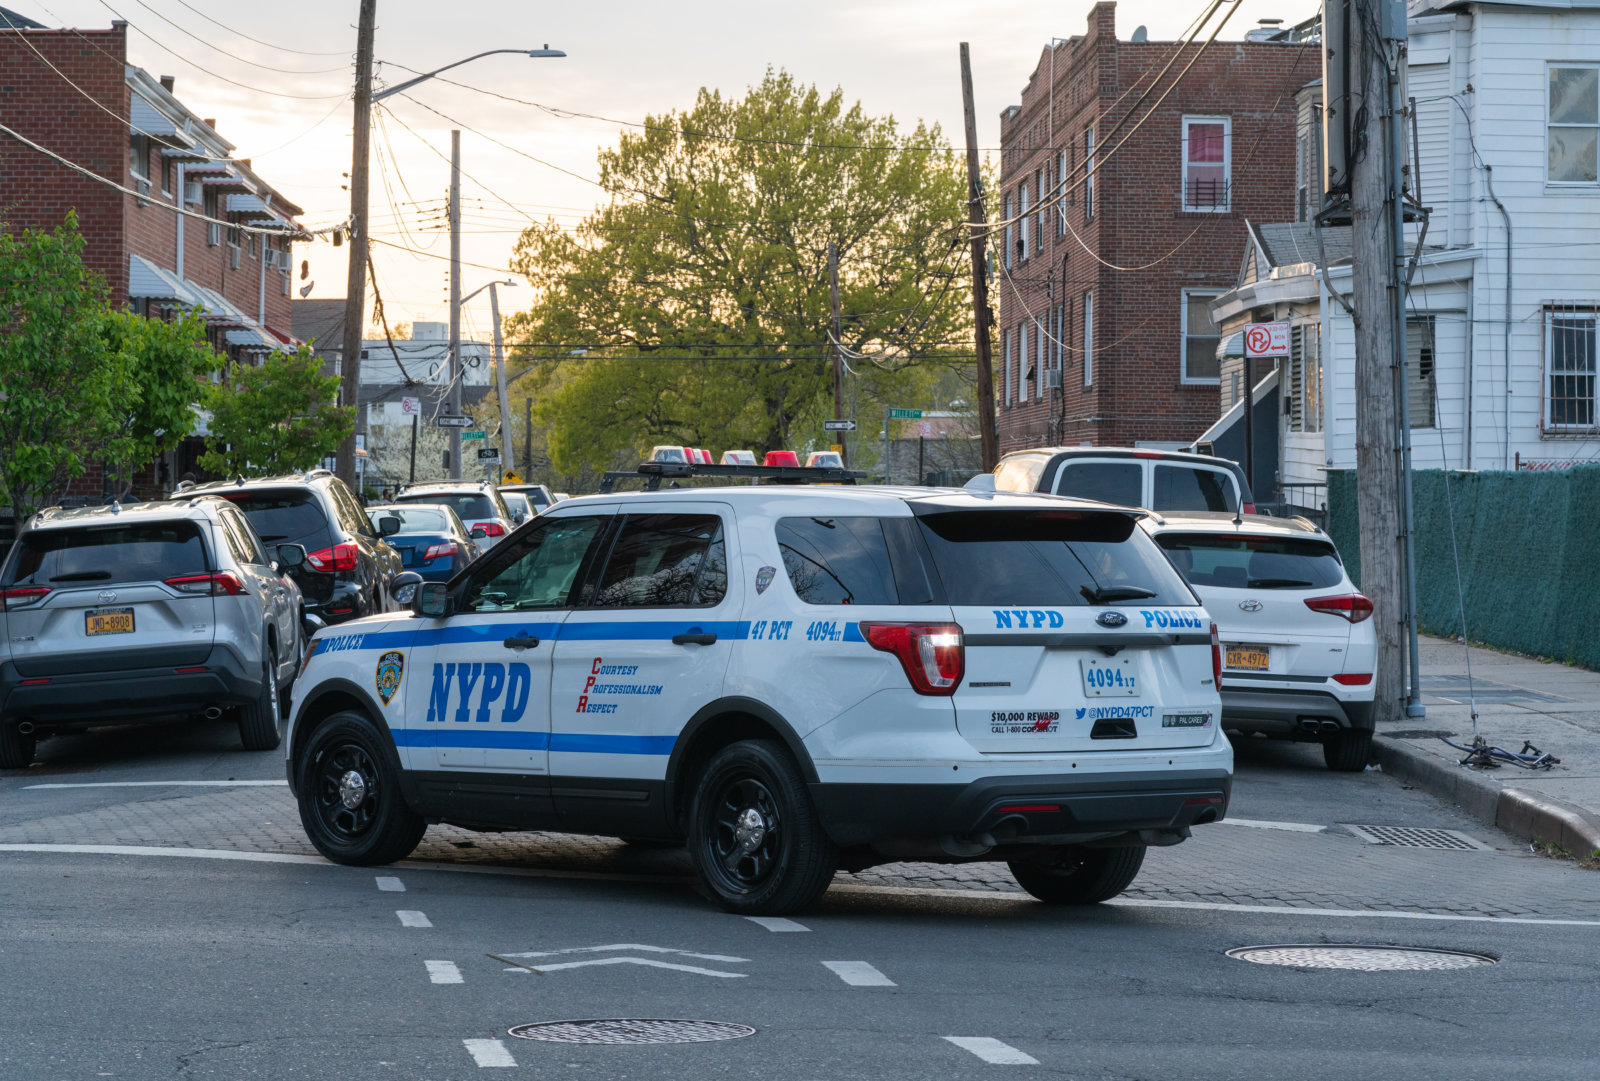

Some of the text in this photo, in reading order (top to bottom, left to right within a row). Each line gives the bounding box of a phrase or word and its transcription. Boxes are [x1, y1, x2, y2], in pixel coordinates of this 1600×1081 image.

[993, 610, 1064, 628] NYPD
[1140, 610, 1202, 628] POLICE
[751, 621, 793, 640] 47 PCT
[326, 634, 363, 652] POLICE
[591, 657, 638, 675] COURTESY
[426, 662, 531, 722] NYPD
[583, 676, 663, 695] PROFESSIONALISM
[576, 696, 618, 714] RESPECT
[1088, 706, 1154, 718] @NYPD47PCT
[991, 711, 1060, 723] $10,000 REWARD
